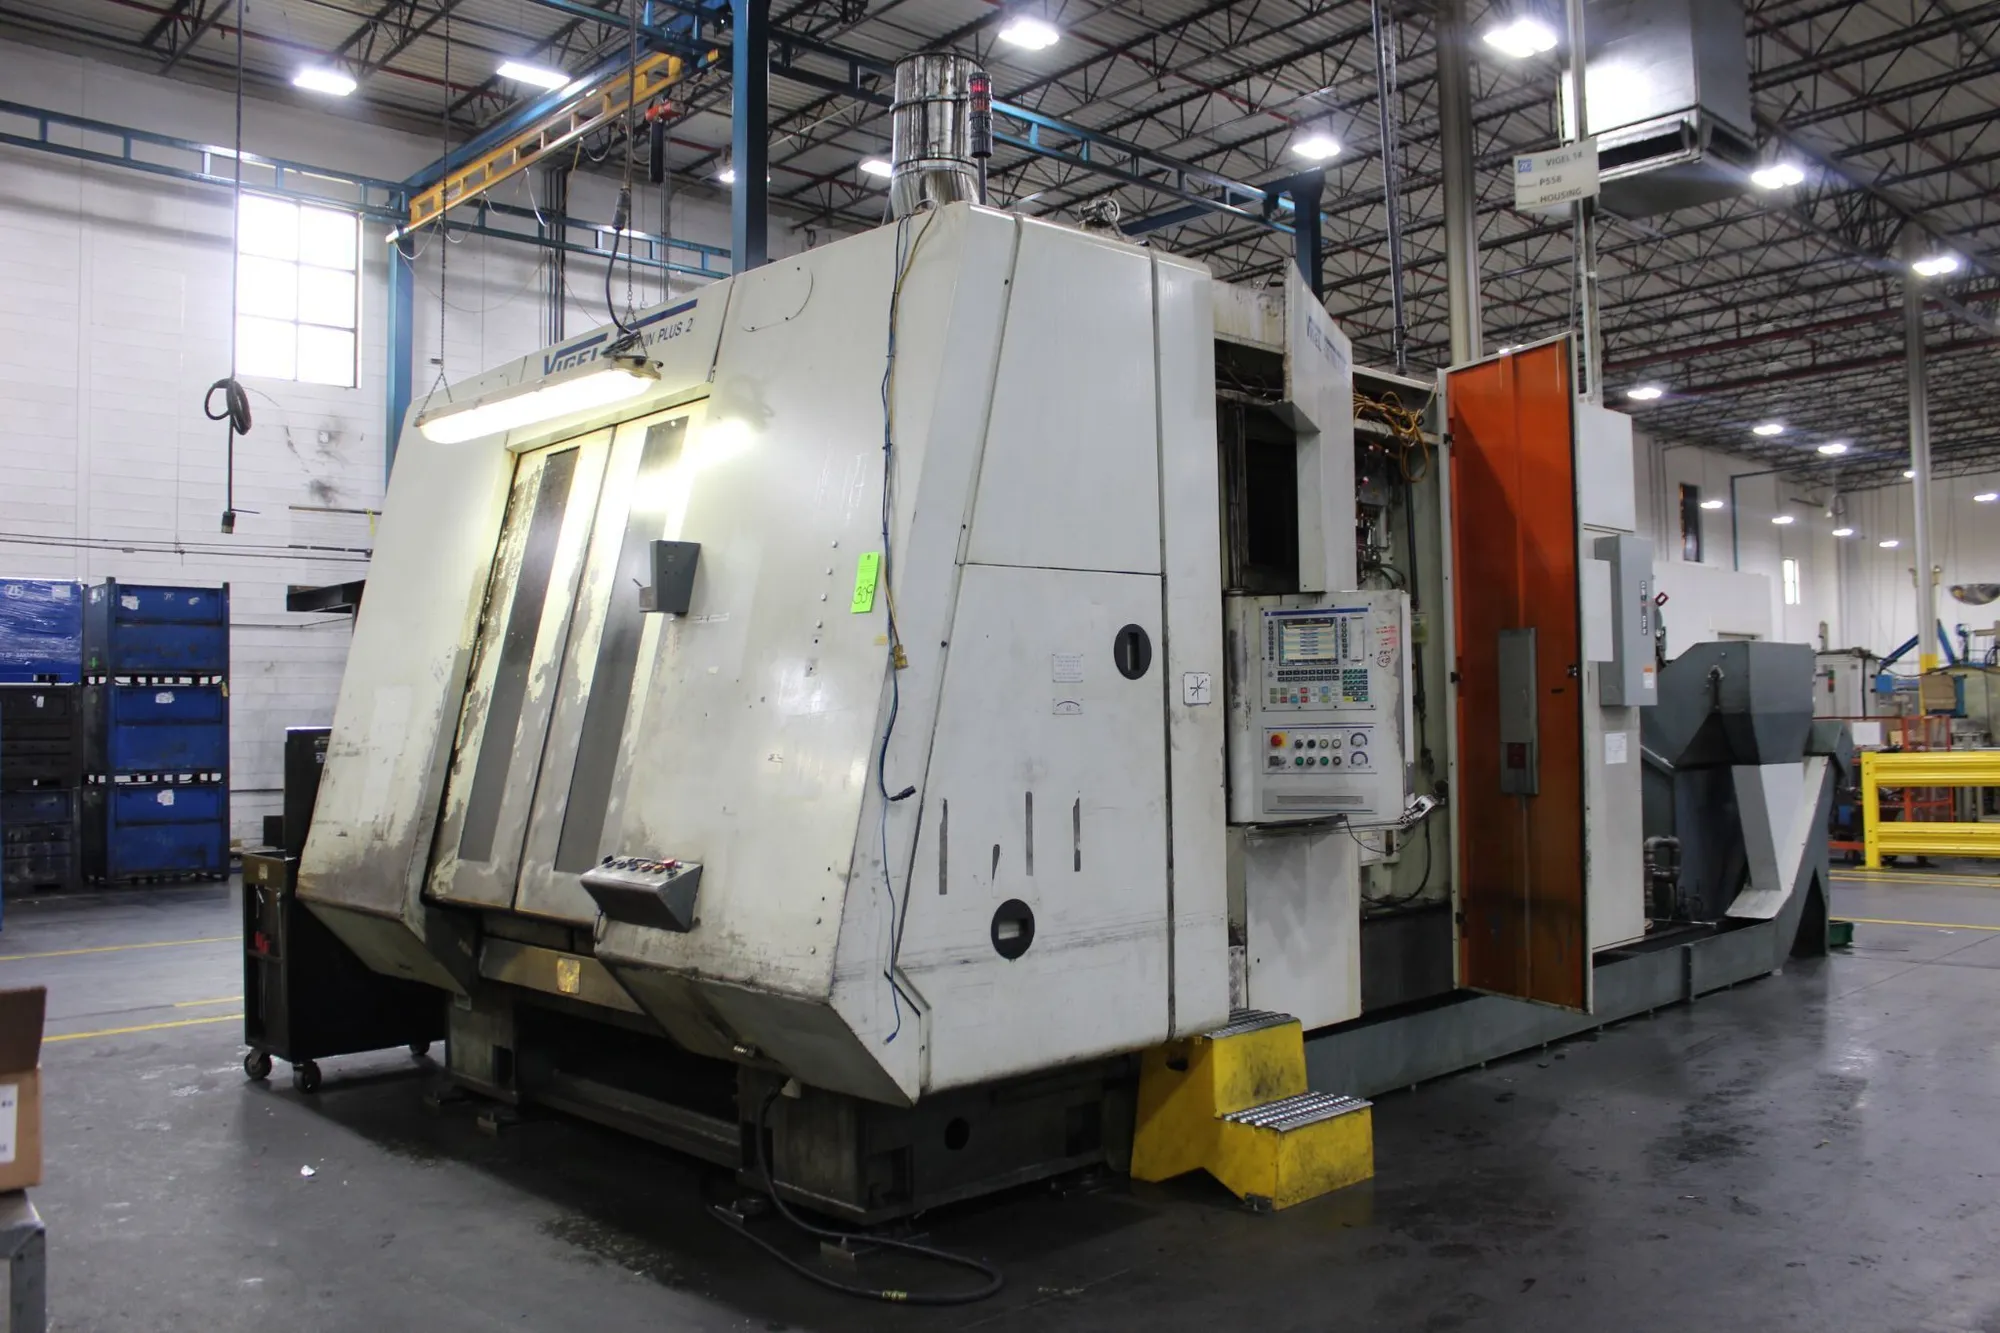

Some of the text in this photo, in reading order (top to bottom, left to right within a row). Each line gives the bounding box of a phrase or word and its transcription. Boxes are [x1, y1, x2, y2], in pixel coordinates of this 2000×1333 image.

[1539, 187, 1582, 203] HOUSING
[657, 321, 683, 343] PLUS
[685, 317, 693, 333] 2
